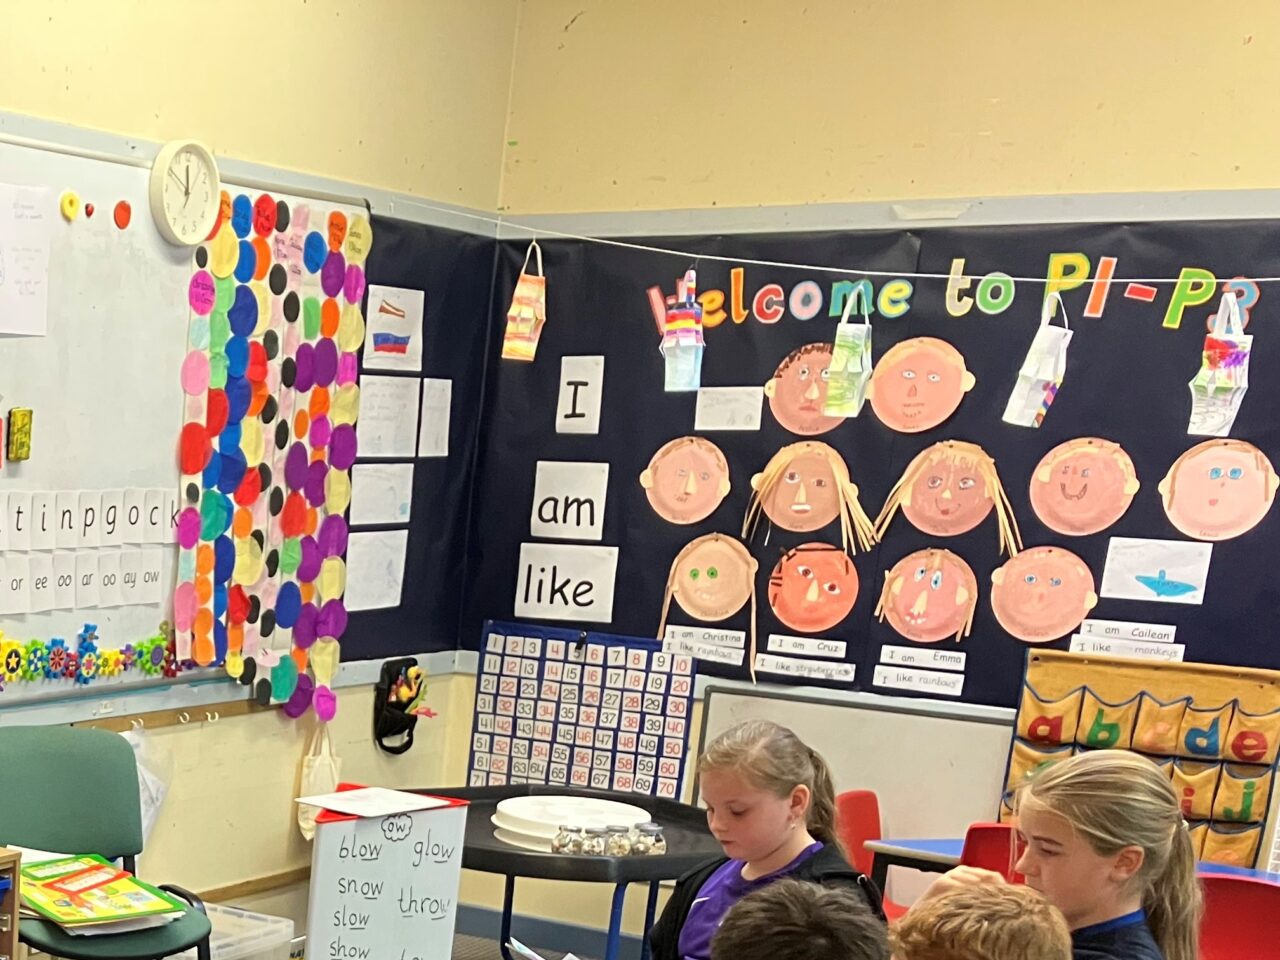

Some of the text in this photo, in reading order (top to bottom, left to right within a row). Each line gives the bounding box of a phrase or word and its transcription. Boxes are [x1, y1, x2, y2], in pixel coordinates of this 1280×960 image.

[945, 258, 1015, 317] to
[563, 381, 589, 419] I
[15, 505, 25, 532] t
[41, 503, 47, 532] i
[60, 506, 73, 530] n
[83, 506, 96, 537] p
[105, 505, 117, 535] g
[128, 505, 139, 525] o
[149, 503, 159, 526] c
[170, 500, 180, 528] k
[537, 496, 595, 527] am
[11, 577, 23, 591] or
[35, 576, 48, 590] ee
[58, 574, 72, 587] oo
[82, 572, 93, 586] ar
[103, 573, 116, 587] oo
[123, 571, 137, 588] ay
[144, 570, 159, 583] ow
[524, 563, 595, 608] like
[702, 629, 741, 642] Christina
[1086, 623, 1170, 640] I am Cailean
[493, 637, 498, 648] 1
[512, 641, 518, 652] 2
[529, 642, 536, 653] 3
[552, 644, 559, 655] 4
[591, 649, 598, 660] 6
[613, 650, 620, 662] 7
[633, 653, 640, 665] 8
[658, 655, 665, 667] 9
[676, 660, 687, 672] 10
[680, 642, 693, 653] like
[778, 639, 839, 653] I am Cruz
[890, 650, 962, 664] I am Emma
[1080, 643, 1178, 660] I like monkeys
[488, 655, 688, 693] 11 12 13 14 15 16 17 18 19 20
[760, 658, 766, 667] I
[775, 661, 791, 672] like
[896, 673, 913, 682] like
[483, 678, 685, 713] 21 22 23 24 25 26 27 28 29 30
[1028, 715, 1064, 743] a
[1087, 708, 1121, 748] b
[1185, 716, 1220, 756] d
[1231, 730, 1268, 761] e
[388, 821, 406, 833] ow
[339, 829, 455, 867] blow glow
[338, 878, 450, 915] snow throw
[333, 904, 370, 927] slow
[330, 936, 370, 960] show
